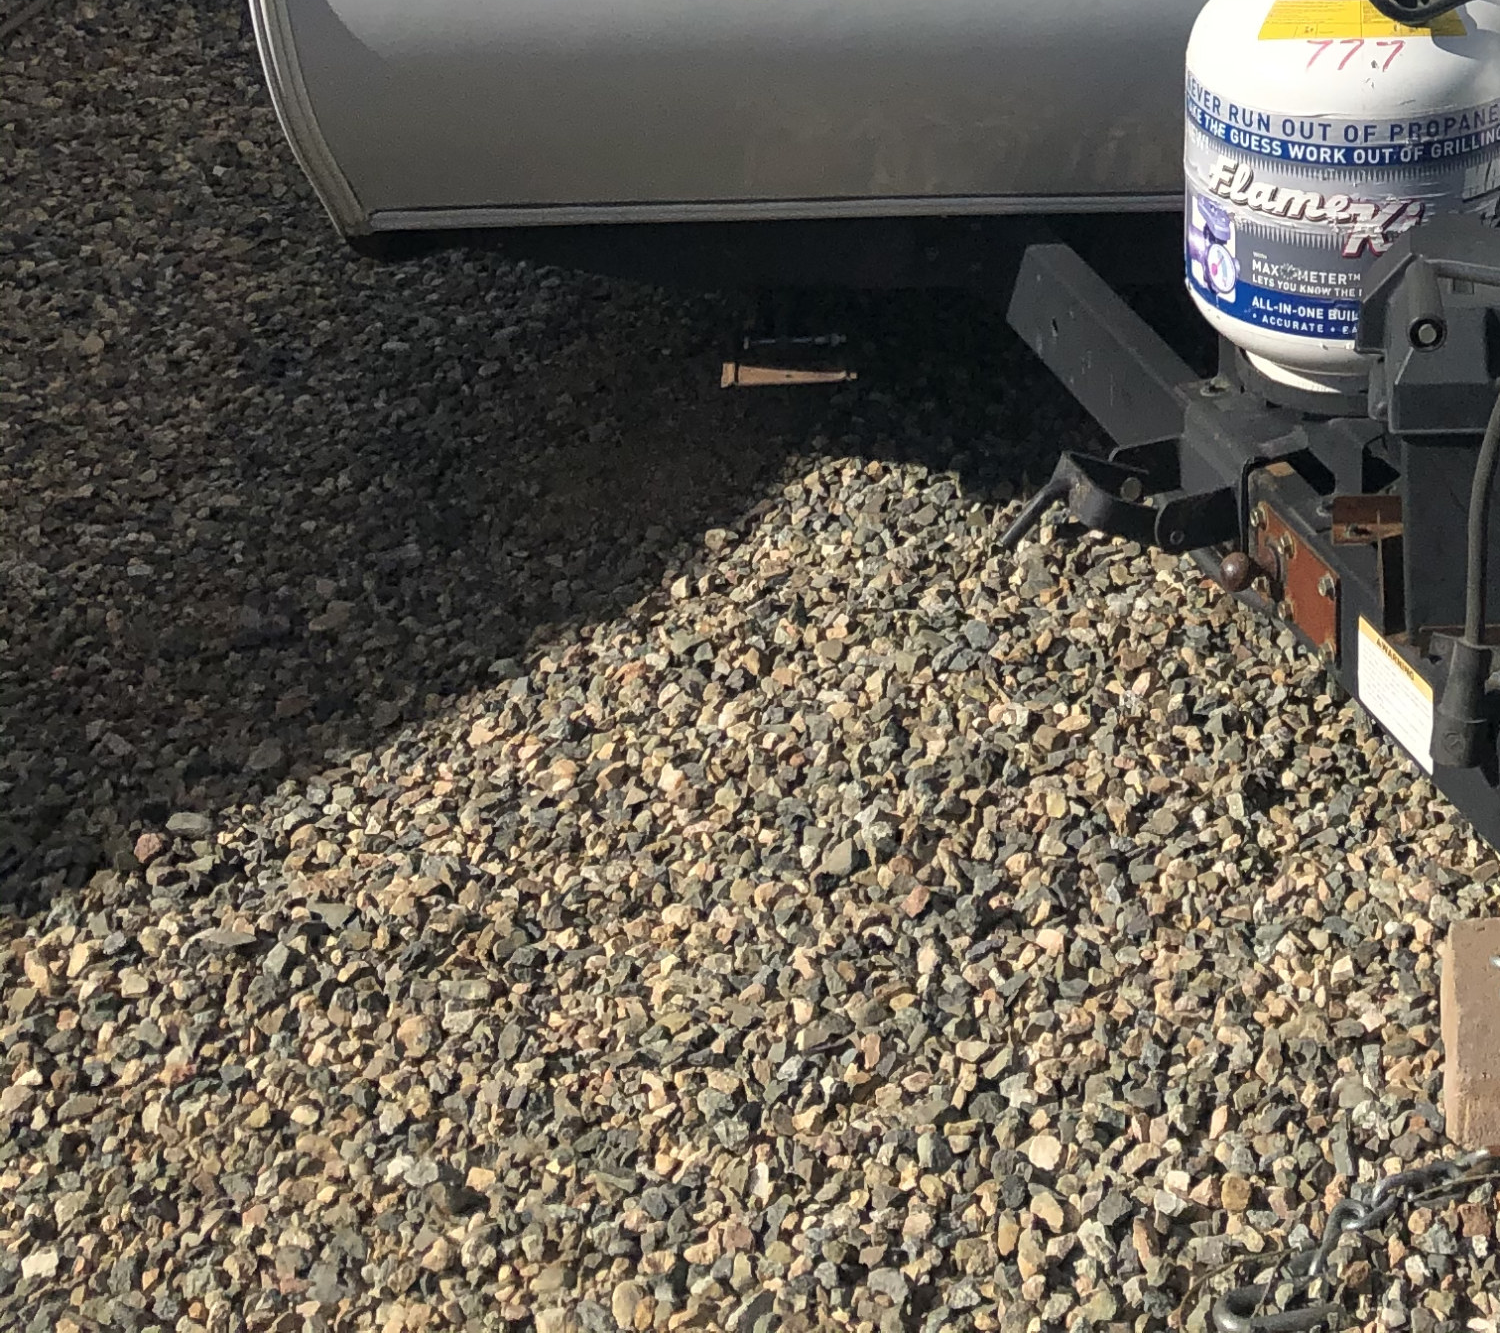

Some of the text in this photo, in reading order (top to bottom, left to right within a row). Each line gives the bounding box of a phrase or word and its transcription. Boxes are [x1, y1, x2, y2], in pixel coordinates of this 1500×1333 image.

[1187, 91, 1206, 128] AKE
[1204, 113, 1227, 141] THE
[1230, 128, 1283, 157] GUESS
[1288, 144, 1347, 164] WORK
[1353, 148, 1394, 165] OUT
[1400, 143, 1424, 163] OF
[1228, 105, 1271, 133] RUN
[1281, 118, 1332, 142] OUT
[1343, 125, 1378, 143] OF
[1209, 153, 1425, 258] Flame Ki
[1252, 273, 1275, 288] LETS
[1277, 279, 1297, 292] YOU
[1299, 283, 1332, 296] KNOW
[1334, 287, 1356, 298] THE
[1252, 295, 1360, 322] ALL-IN-ONE BUIL
[1262, 314, 1358, 335] ACCURATE EA
